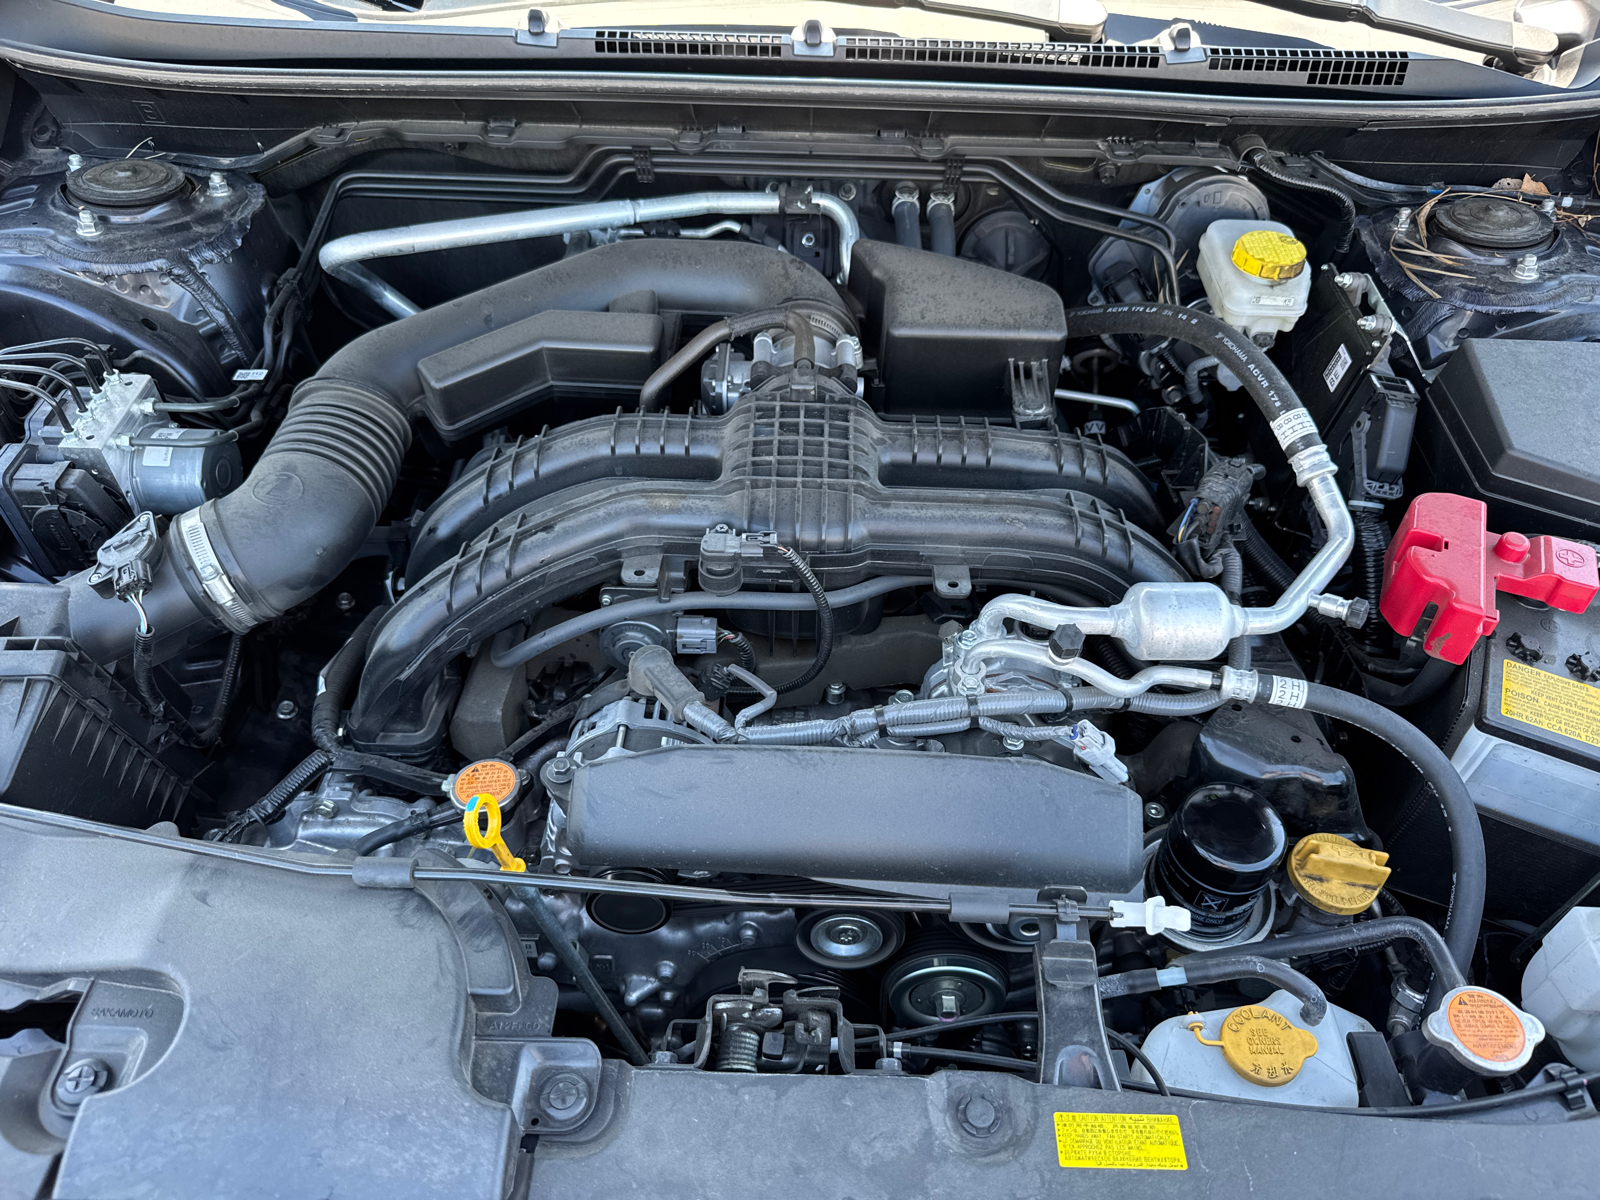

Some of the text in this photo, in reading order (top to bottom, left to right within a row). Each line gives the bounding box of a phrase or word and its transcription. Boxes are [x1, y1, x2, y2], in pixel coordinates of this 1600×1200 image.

[1222, 336, 1248, 363] YOKOHAMA
[1248, 363, 1270, 388] ACVR
[1506, 661, 1541, 678] DANGER
[1544, 674, 1570, 686] EXPLOSIVE
[1572, 683, 1589, 692] GASES
[1505, 688, 1539, 704] POISON
[1544, 701, 1564, 712] CAUSES
[1546, 695, 1558, 703] VENT
[1559, 699, 1573, 707] CAPS
[1505, 708, 1524, 720] 20HR
[1525, 715, 1544, 726] 62Ah
[1546, 722, 1563, 733] CCA
[1564, 728, 1582, 740] 620A
[1444, 884, 1456, 930] YOKOHAMA
[91, 1007, 154, 1019] SAKAMOTO
[1226, 1006, 1293, 1033] COOLANT
[1249, 1028, 1269, 1037] SEE
[1249, 1046, 1285, 1055] MANUAL
[1078, 1114, 1099, 1122] CAUTION
